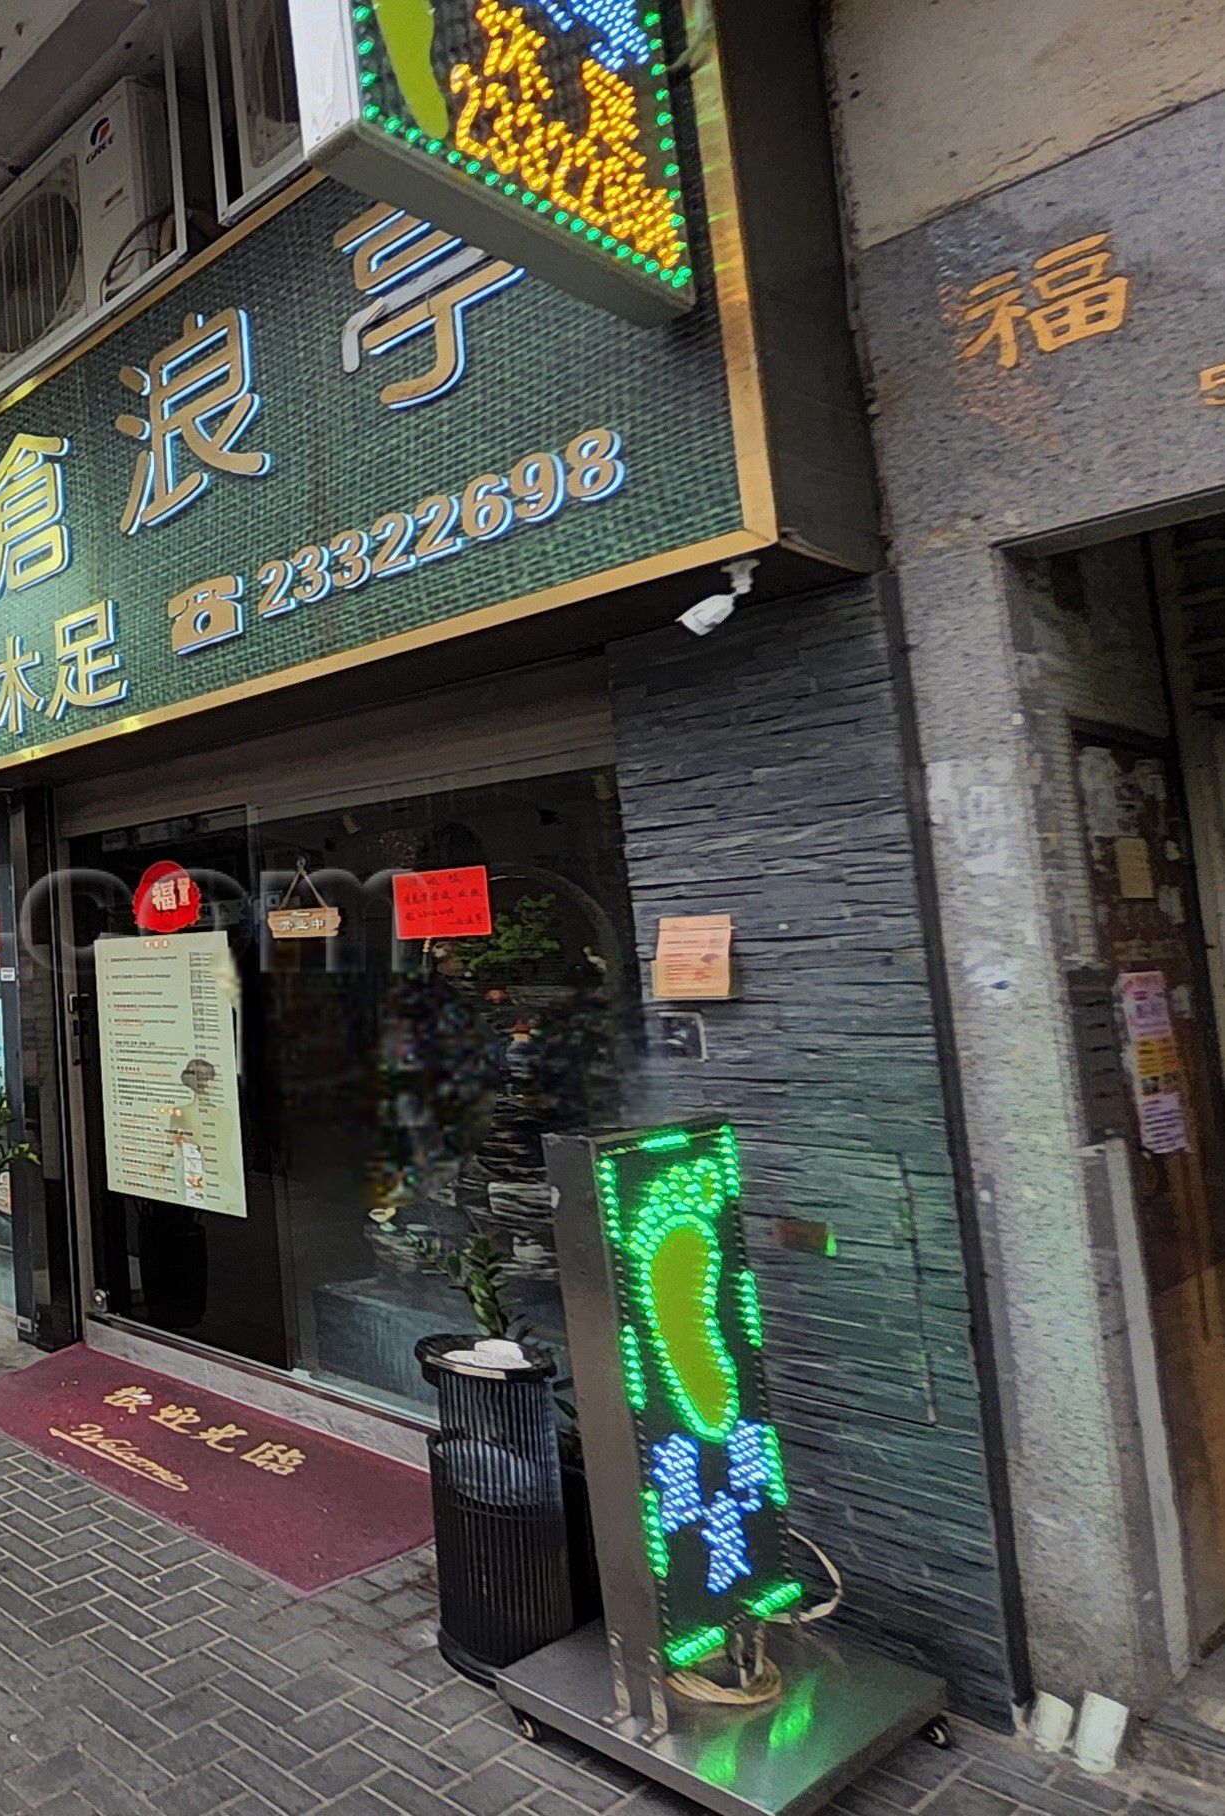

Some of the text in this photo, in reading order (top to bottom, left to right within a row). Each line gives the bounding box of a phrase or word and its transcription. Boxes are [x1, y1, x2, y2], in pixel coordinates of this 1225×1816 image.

[956, 230, 1129, 369] 福
[257, 427, 625, 619] 23322698
[59, 1423, 188, 1490] Welcome
